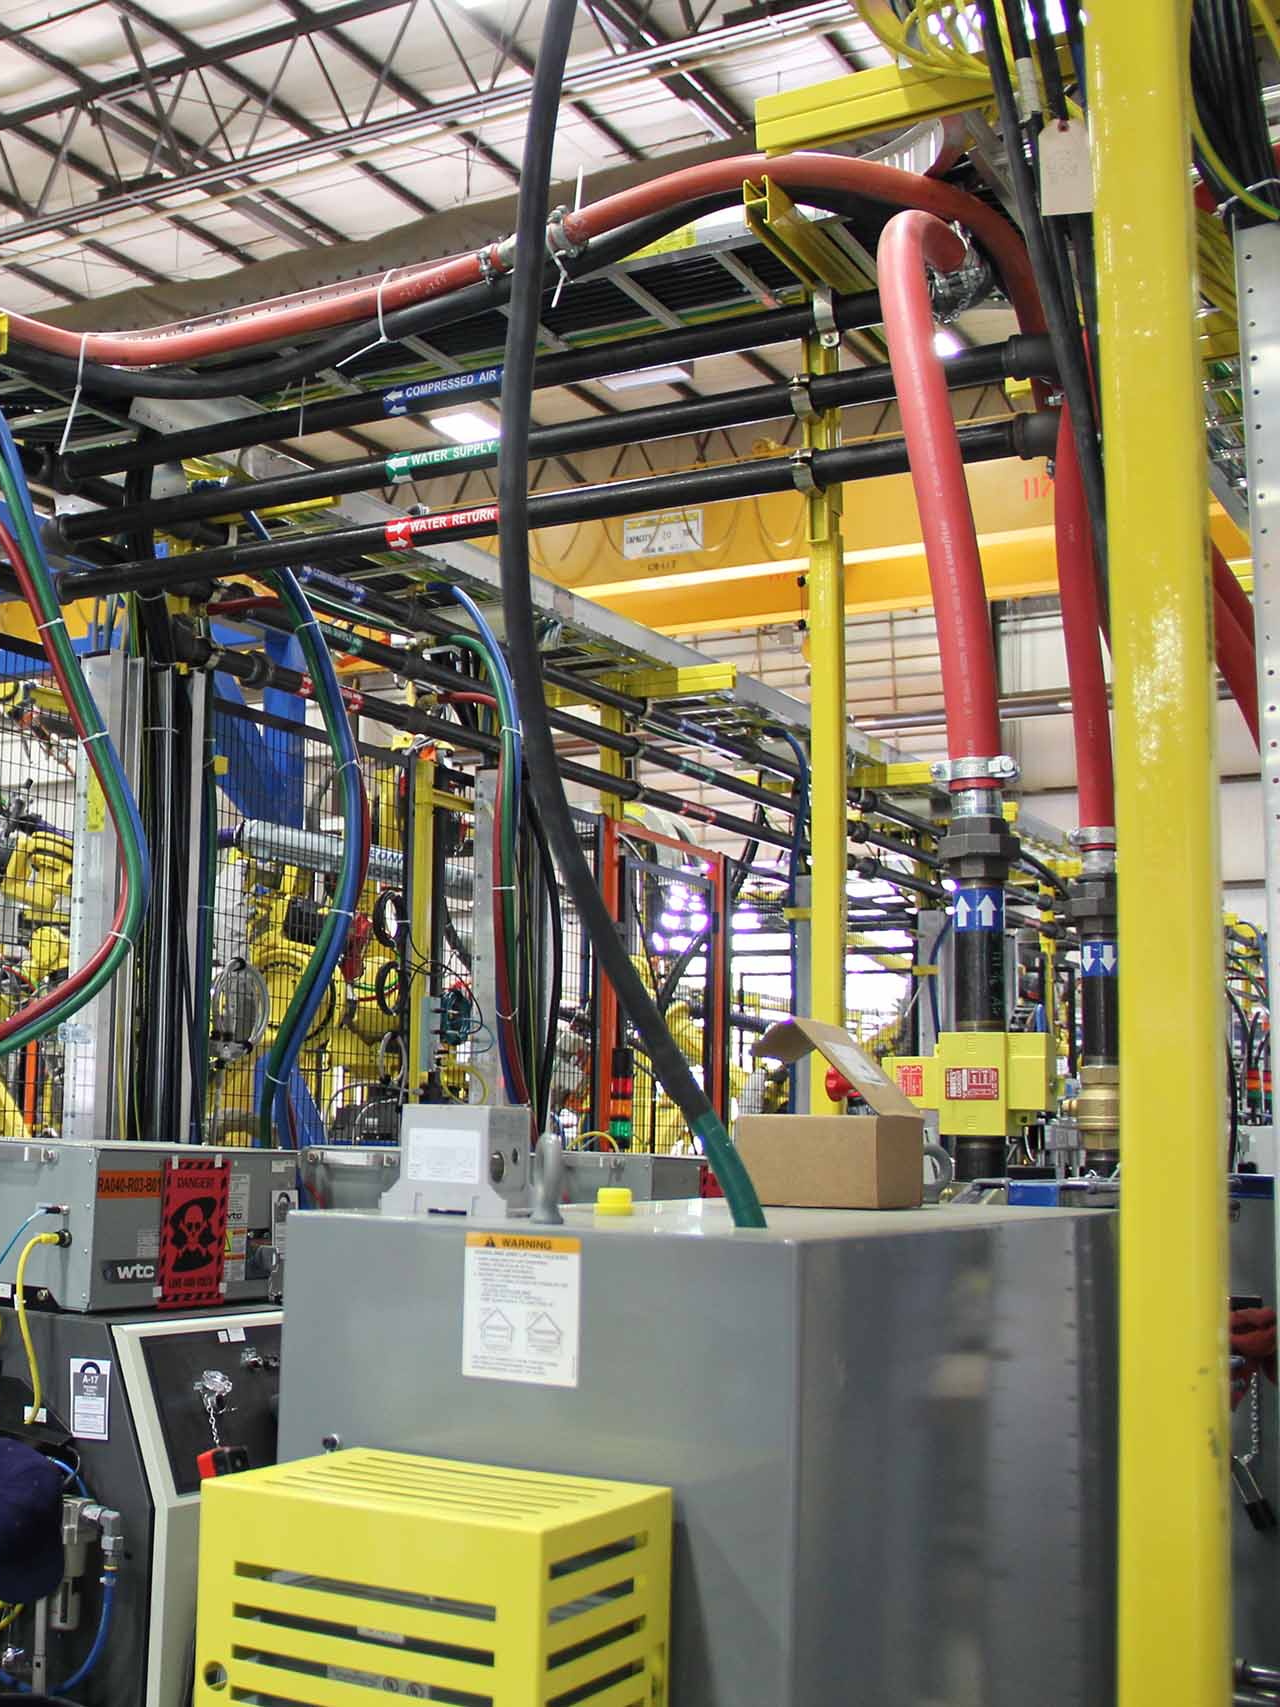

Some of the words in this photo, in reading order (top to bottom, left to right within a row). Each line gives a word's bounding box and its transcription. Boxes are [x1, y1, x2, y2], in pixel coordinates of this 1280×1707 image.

[405, 374, 474, 398] COMPRESSED
[479, 370, 497, 383] AIR
[410, 449, 449, 466] WATER
[452, 441, 494, 458] SUPPLY
[409, 516, 447, 532] WATER
[452, 509, 496, 526] RETURN
[97, 1176, 161, 1192] RA040-R03-B01
[502, 1237, 552, 1250] WARNING
[117, 1264, 155, 1279] wtc
